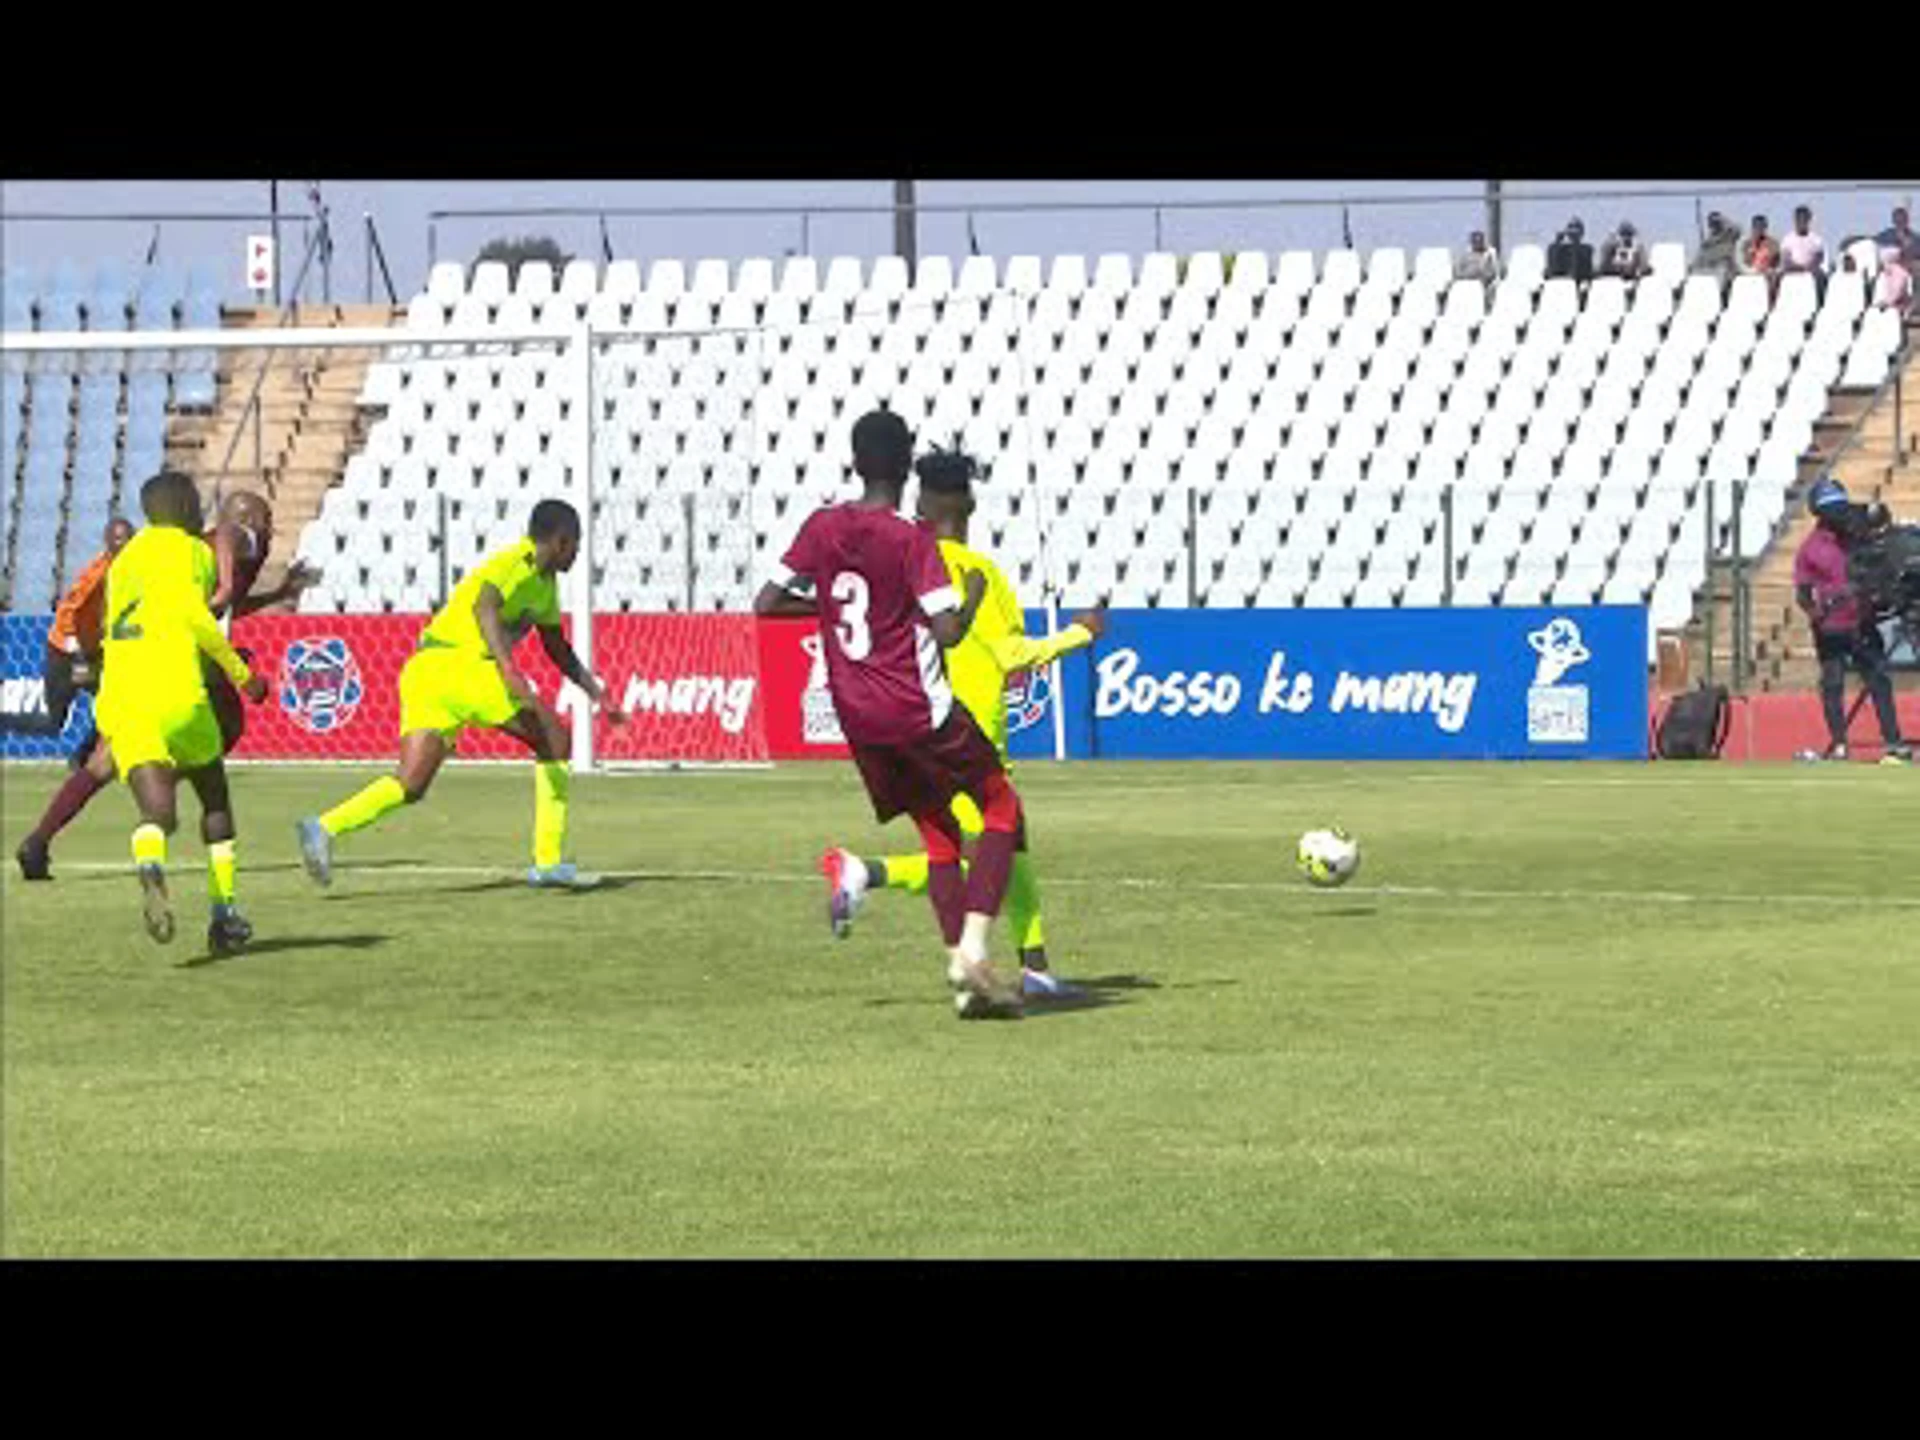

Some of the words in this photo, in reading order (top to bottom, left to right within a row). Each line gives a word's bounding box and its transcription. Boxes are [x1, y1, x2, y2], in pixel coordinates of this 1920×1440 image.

[831, 571, 871, 660] 3
[622, 672, 756, 733] mang
[1095, 648, 1241, 717] Bosso
[1259, 651, 1313, 713] ke
[1330, 671, 1477, 732] mang
